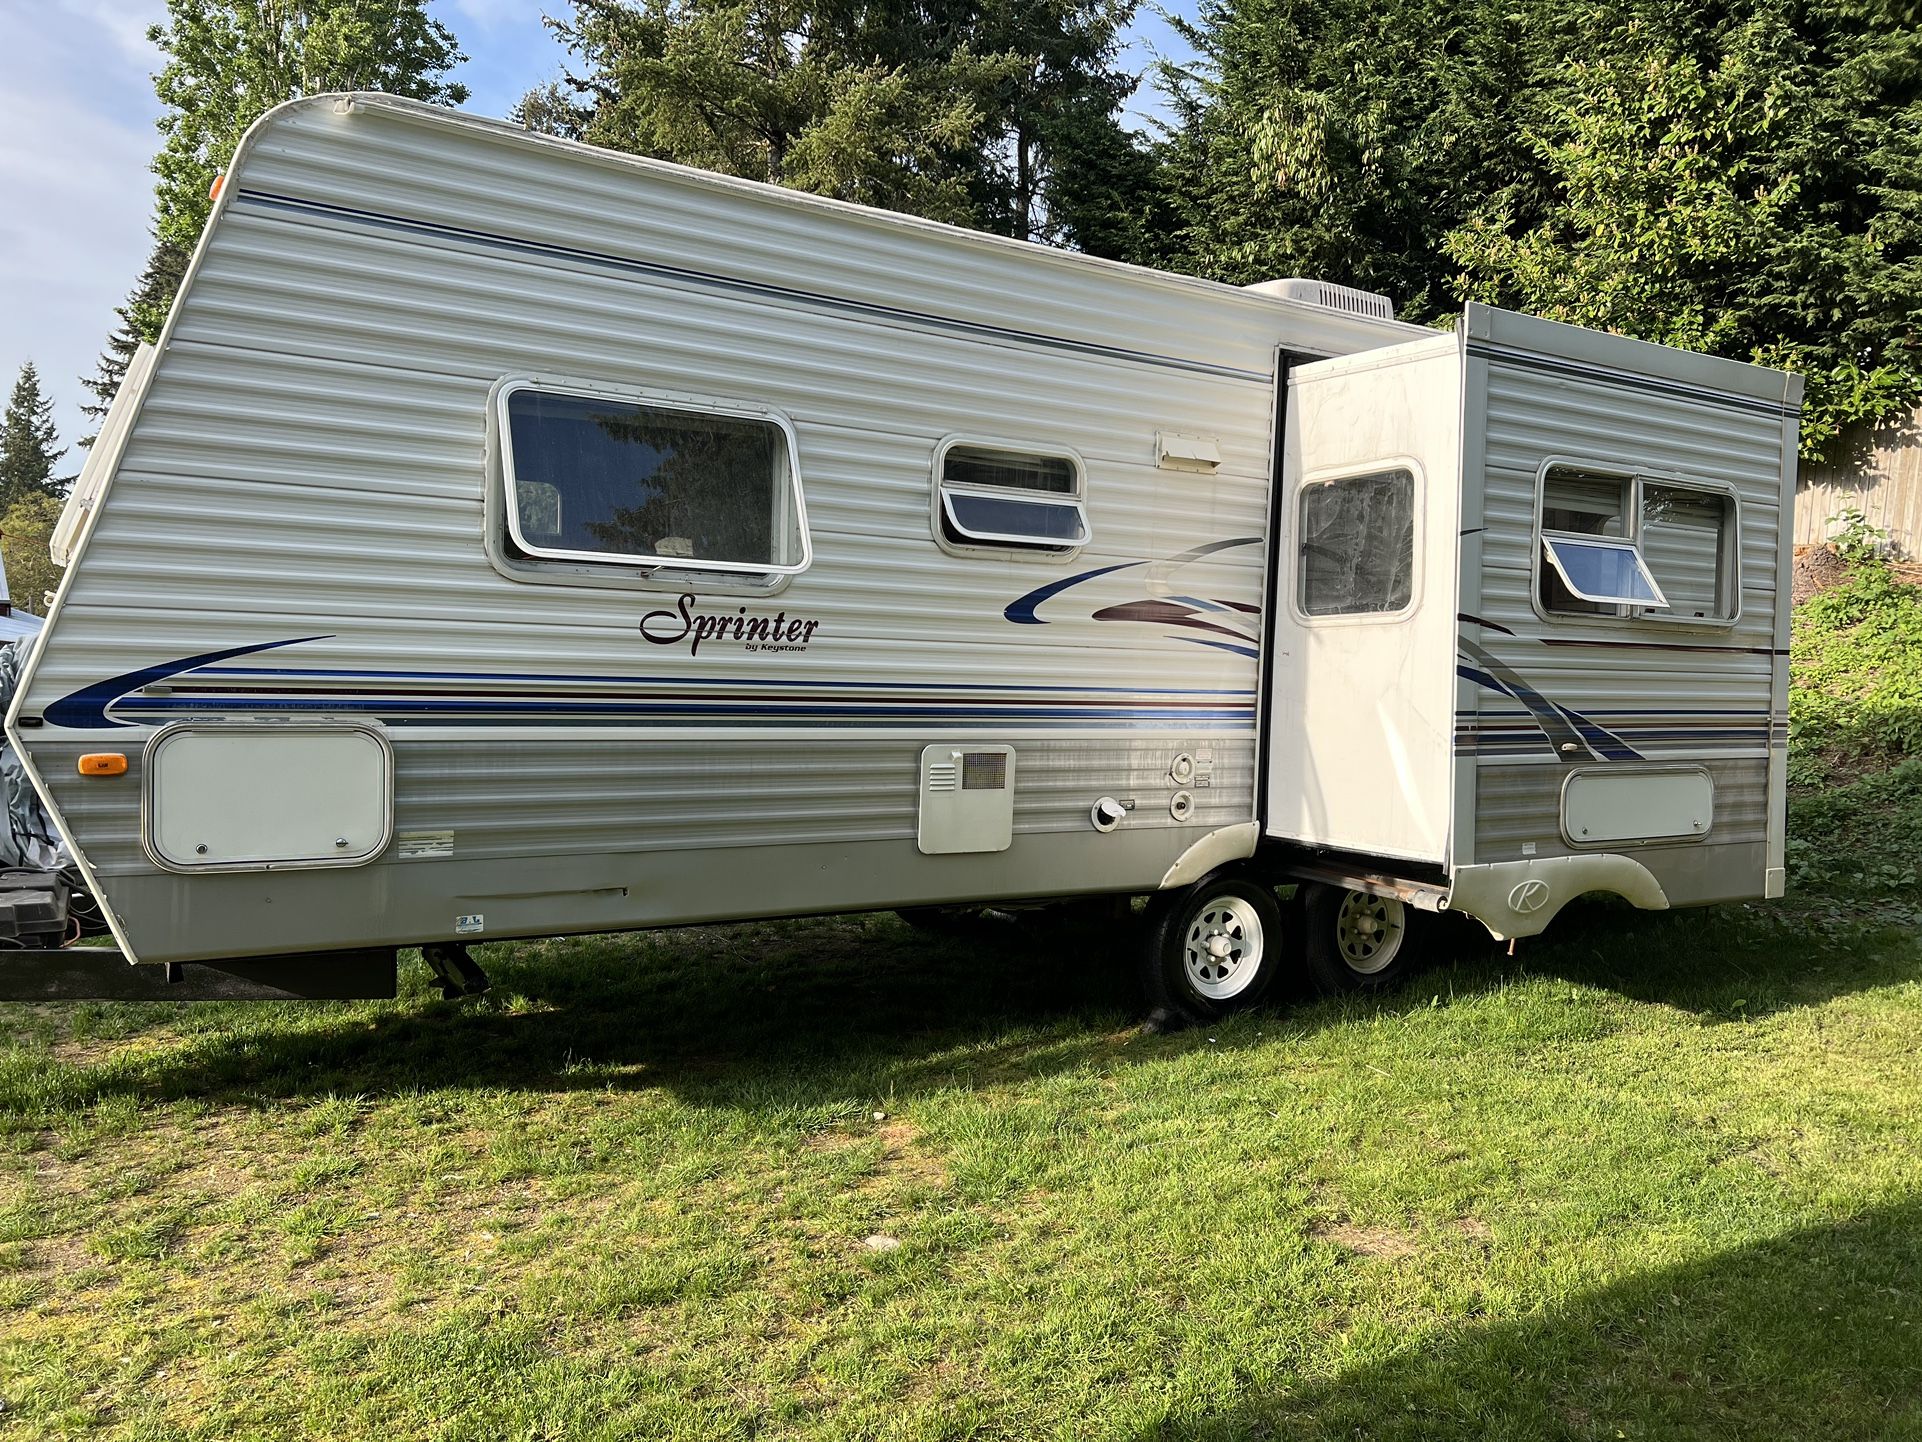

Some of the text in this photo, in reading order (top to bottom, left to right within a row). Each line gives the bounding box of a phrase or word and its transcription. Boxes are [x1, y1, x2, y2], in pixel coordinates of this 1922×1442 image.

[639, 593, 819, 657] Sprinter
[745, 643, 807, 653] by Keystone
